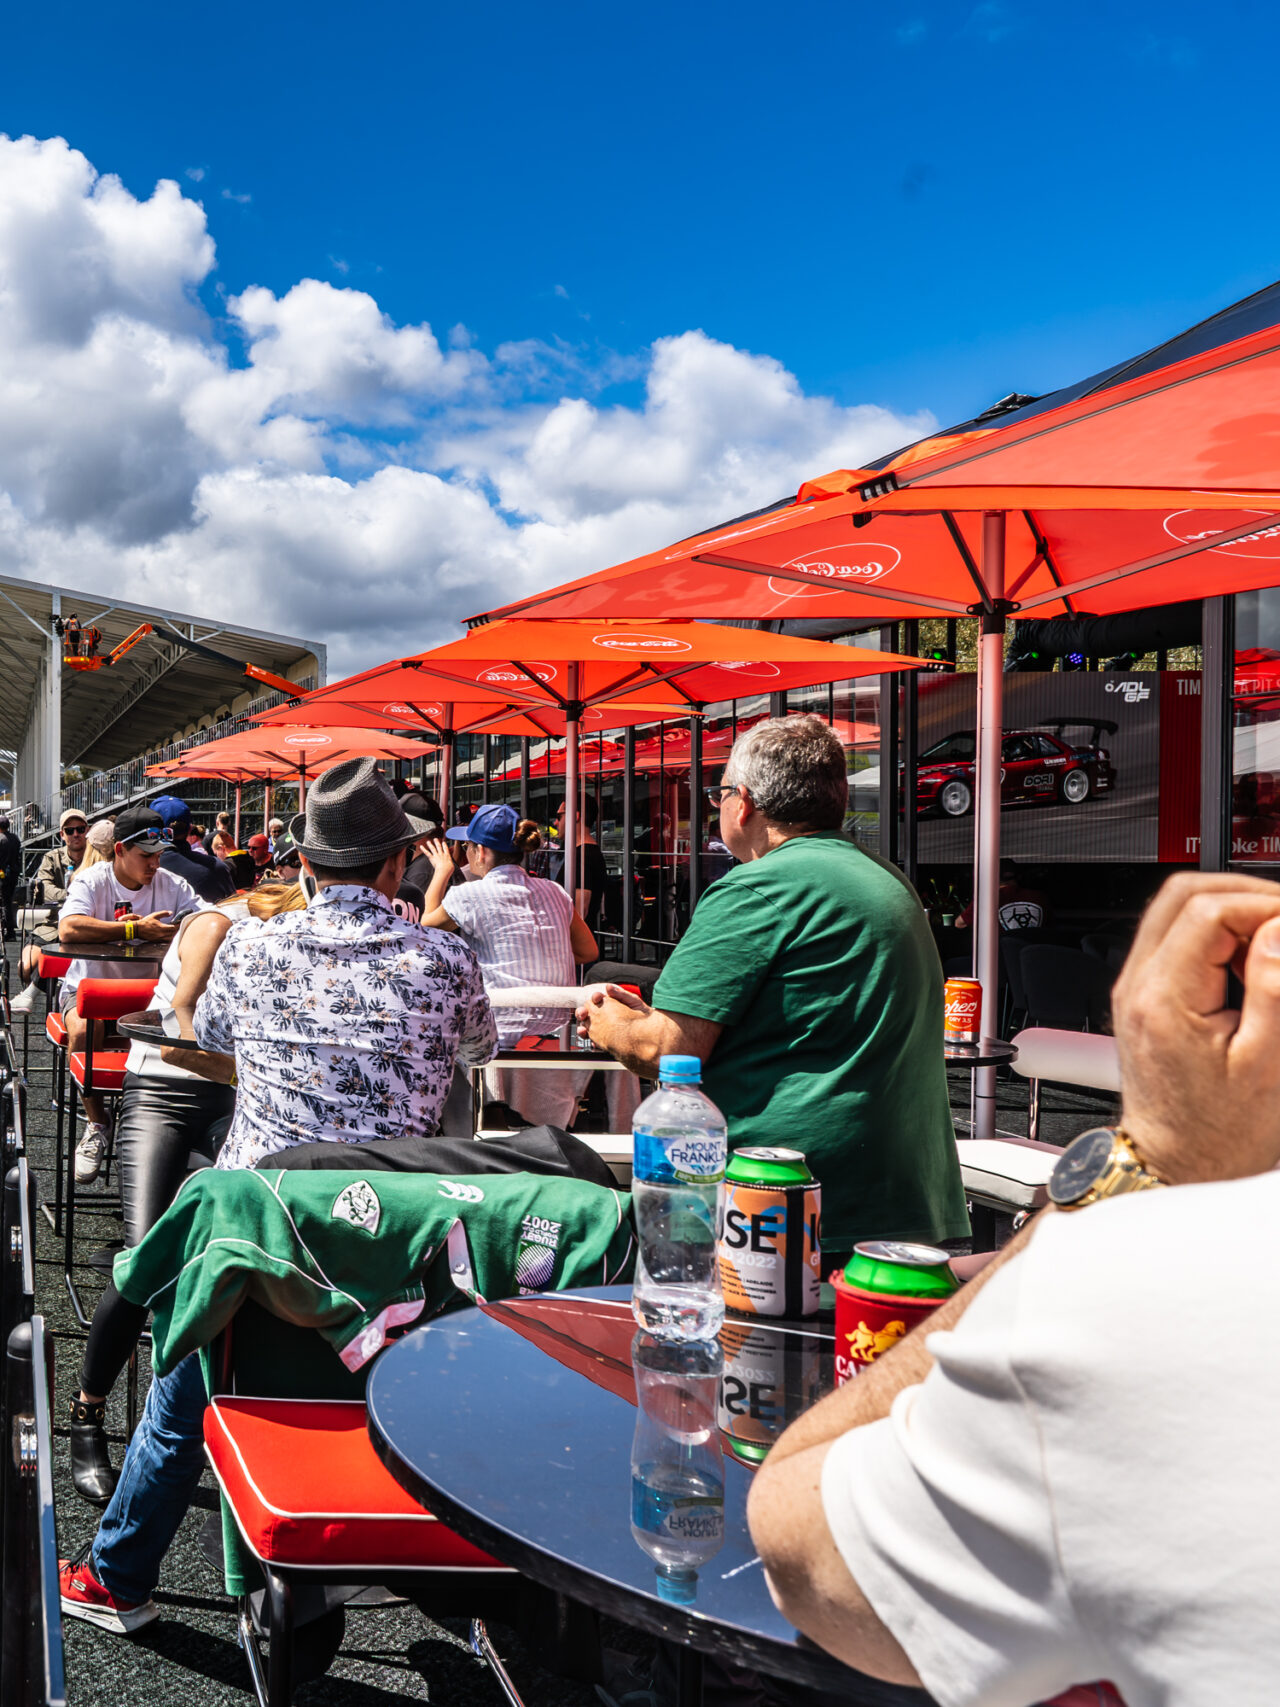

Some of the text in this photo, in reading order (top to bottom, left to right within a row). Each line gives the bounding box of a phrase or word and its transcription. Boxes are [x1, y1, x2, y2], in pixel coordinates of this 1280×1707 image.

[1124, 692, 1150, 703] GF
[685, 1141, 722, 1152] MOUNT
[522, 1214, 562, 1234] 2007
[521, 1231, 557, 1248] RUGBY
[810, 1213, 821, 1253] I
[737, 1252, 778, 1269] 2022
